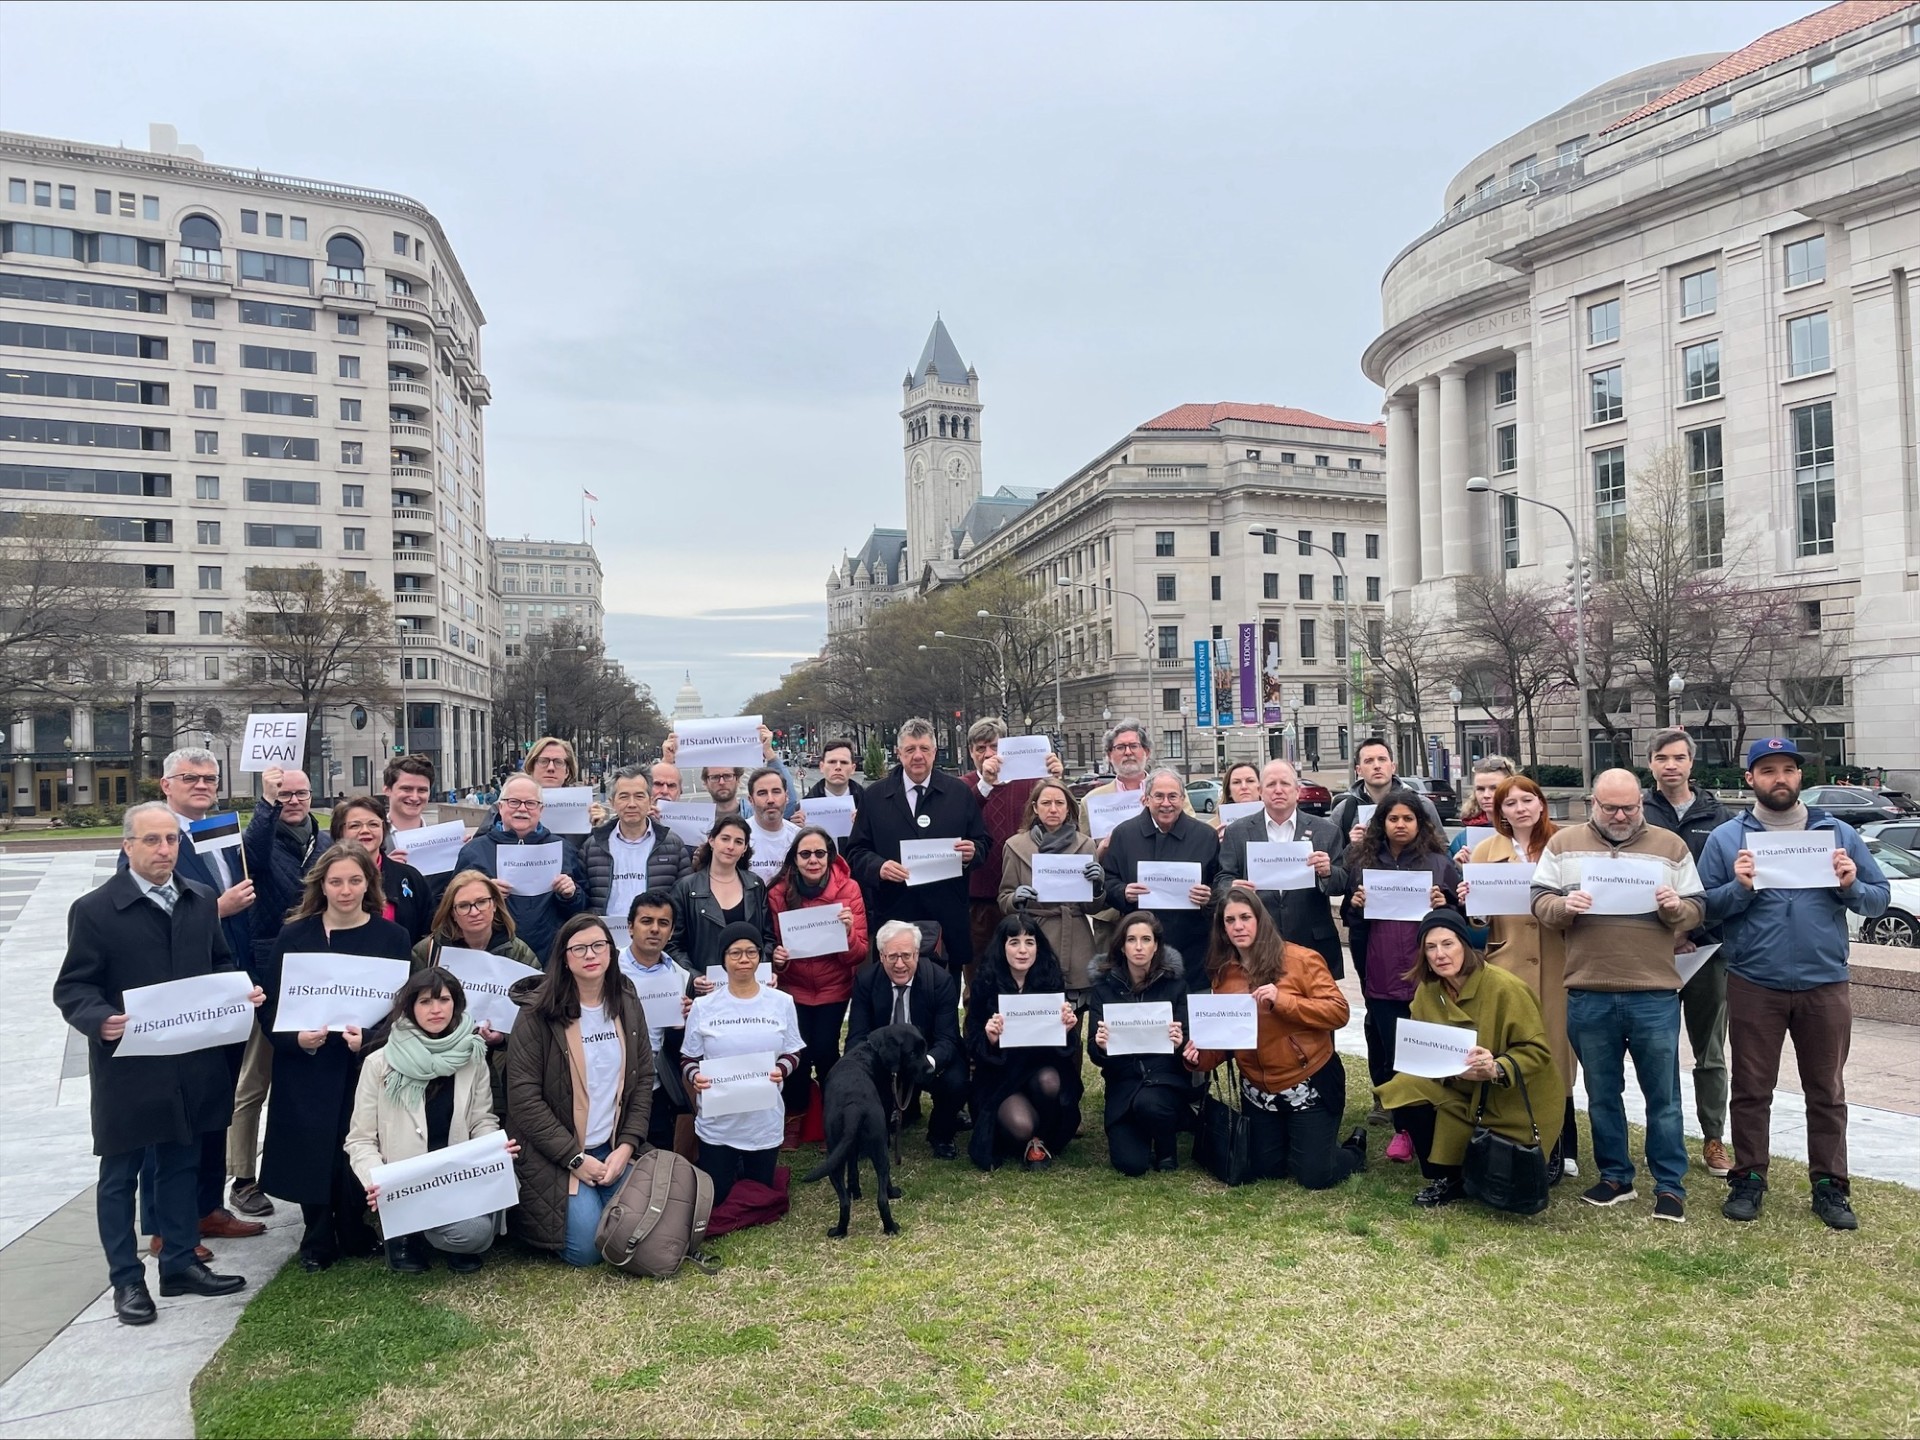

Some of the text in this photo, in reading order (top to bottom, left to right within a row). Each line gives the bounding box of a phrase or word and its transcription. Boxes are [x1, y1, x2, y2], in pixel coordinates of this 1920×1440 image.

[1418, 308, 1531, 358] TRADE CENTER
[1243, 627, 1251, 668] WEDDINGS
[253, 721, 298, 739] FREE
[679, 735, 757, 746] #IStandWithEvan
[251, 744, 297, 762] EVAN
[405, 835, 461, 850] #IStandWithEvan
[1756, 846, 1828, 856] #IStandWithEvan
[503, 859, 558, 868] #IStandWithEvan
[1143, 876, 1196, 884] #IStandWithEvan
[1587, 876, 1655, 886] #IStandWithEvan
[1369, 885, 1427, 893] #IStandWithEvan
[787, 919, 840, 933] #IStandWithEvan
[134, 1002, 246, 1034] #IStandWithEvan
[1195, 1010, 1252, 1018] #IStandWithEvan
[1111, 1019, 1167, 1027] #IStandWithEvan
[1403, 1037, 1469, 1055] #IStandWithEvan
[386, 1161, 505, 1202] #IStandWithEvan
